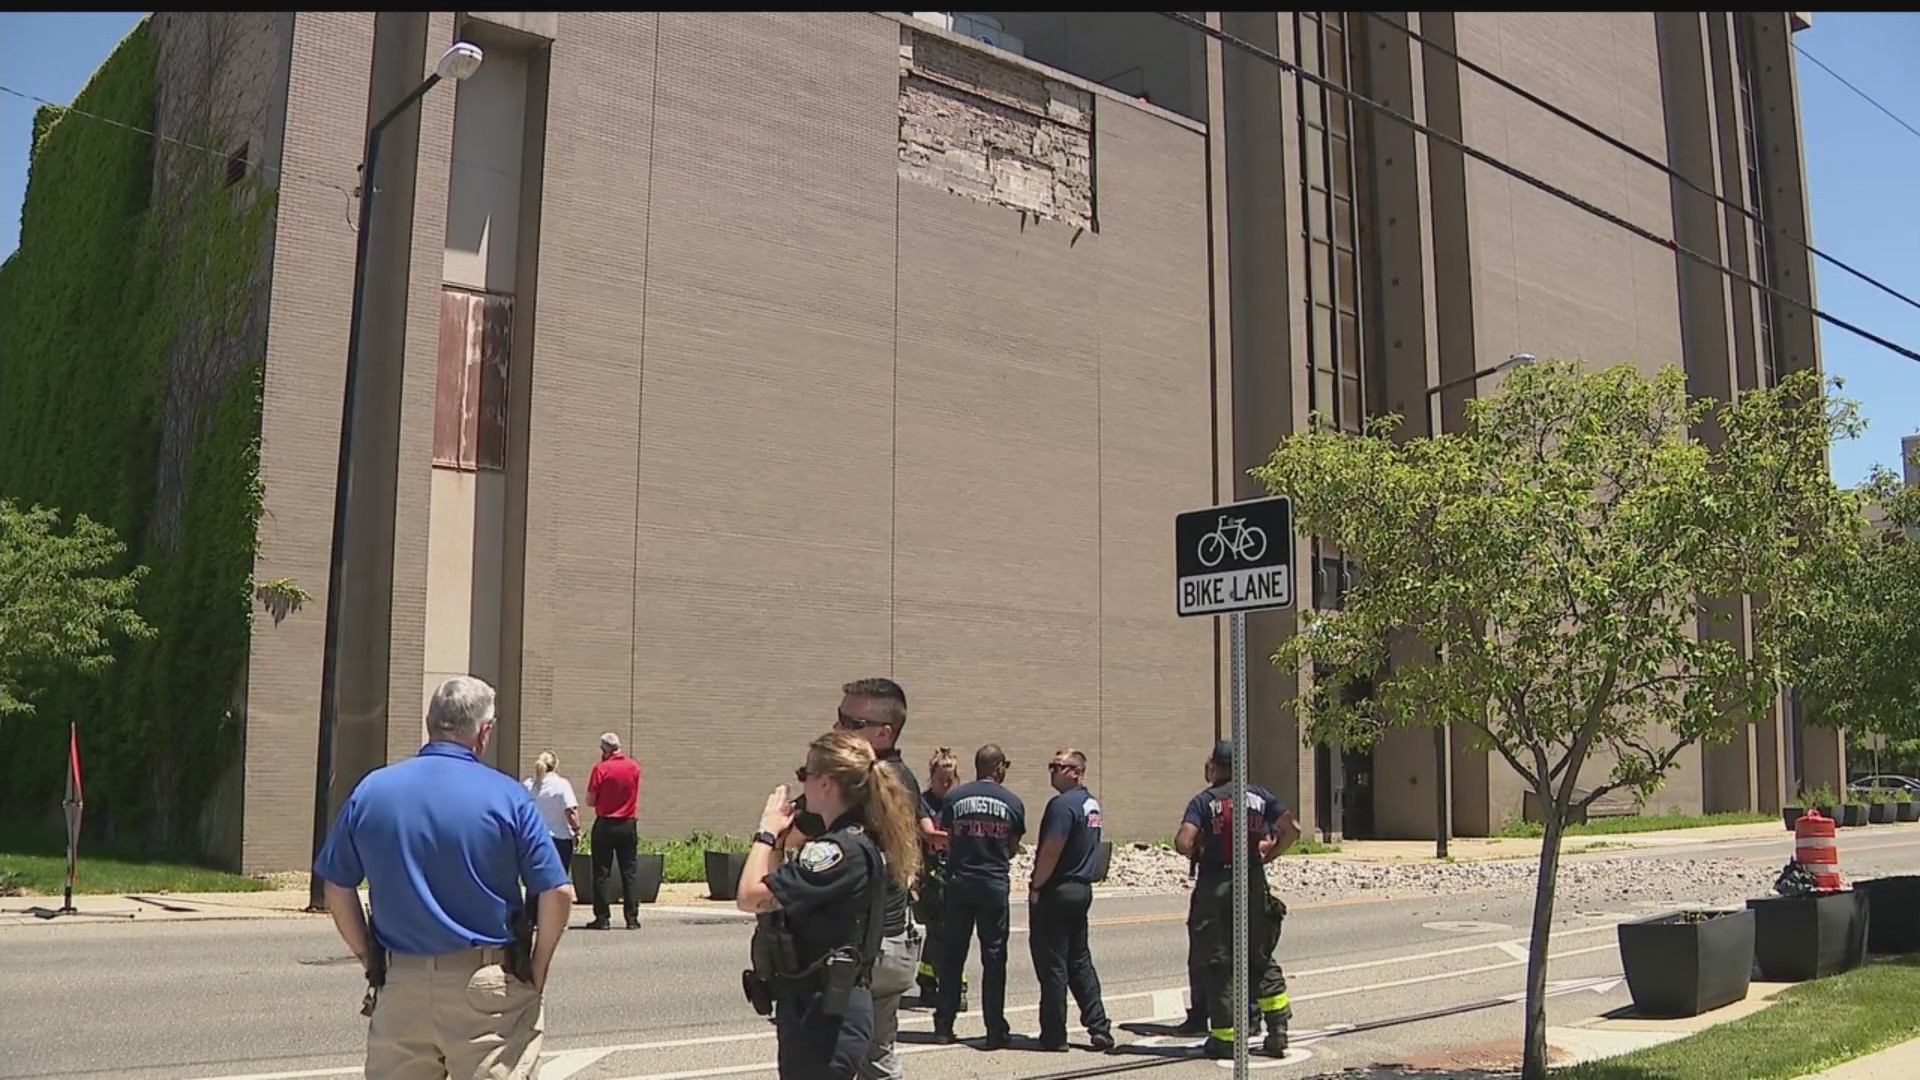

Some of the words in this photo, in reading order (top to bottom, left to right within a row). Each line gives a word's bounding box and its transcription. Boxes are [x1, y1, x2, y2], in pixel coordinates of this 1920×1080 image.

[1184, 577, 1225, 608] BIKE
[1233, 570, 1284, 602] LANE
[952, 795, 1010, 821] YOUNGSTOW
